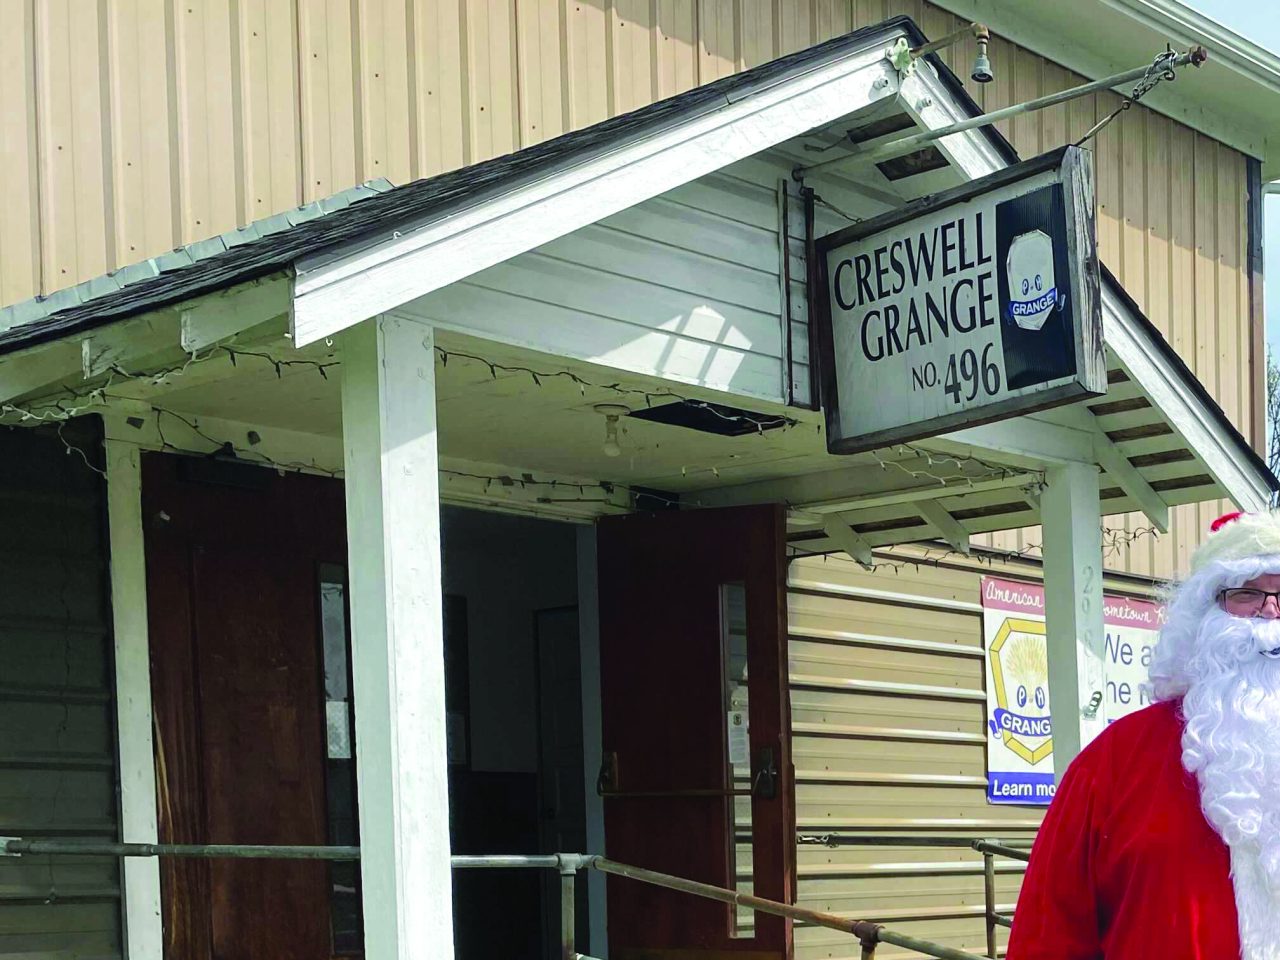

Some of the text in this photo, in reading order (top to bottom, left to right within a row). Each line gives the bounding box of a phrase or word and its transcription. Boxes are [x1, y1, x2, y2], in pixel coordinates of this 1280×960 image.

[833, 211, 992, 311] CRESWELL
[860, 271, 995, 362] GRANGE
[1012, 294, 1055, 315] GRANGE
[912, 342, 1000, 404] NO. 496
[986, 581, 1044, 608] American
[1103, 604, 1152, 623] ometown
[1105, 673, 1132, 705] he
[1001, 713, 1051, 735] GRANG
[993, 778, 1057, 797] Learn mo
